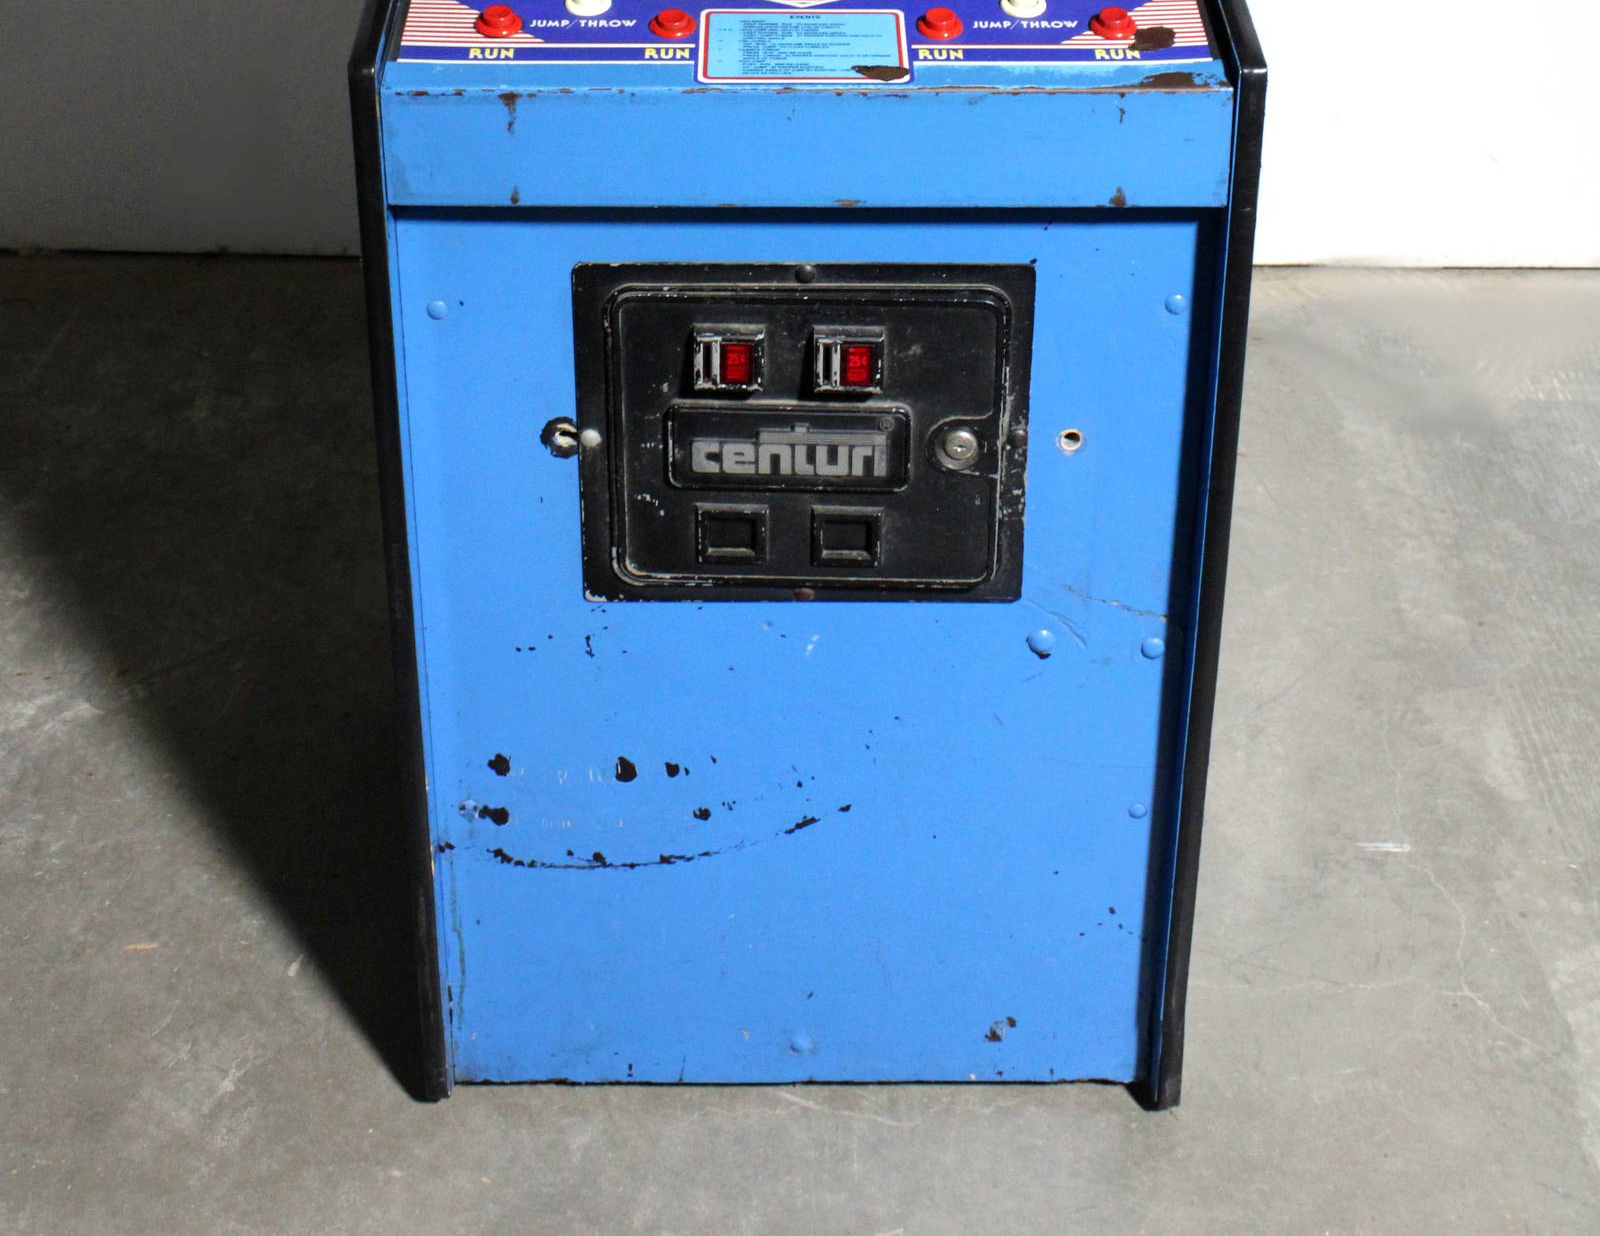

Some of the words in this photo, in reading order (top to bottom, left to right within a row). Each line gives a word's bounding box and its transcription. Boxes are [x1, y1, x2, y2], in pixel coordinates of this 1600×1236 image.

[530, 19, 637, 30] JUMP/THROW
[973, 20, 1079, 30] JUMP/THROW
[468, 47, 515, 60] RUN
[644, 47, 691, 60] RUN
[918, 48, 964, 61] RUN
[1094, 48, 1141, 60] RUN
